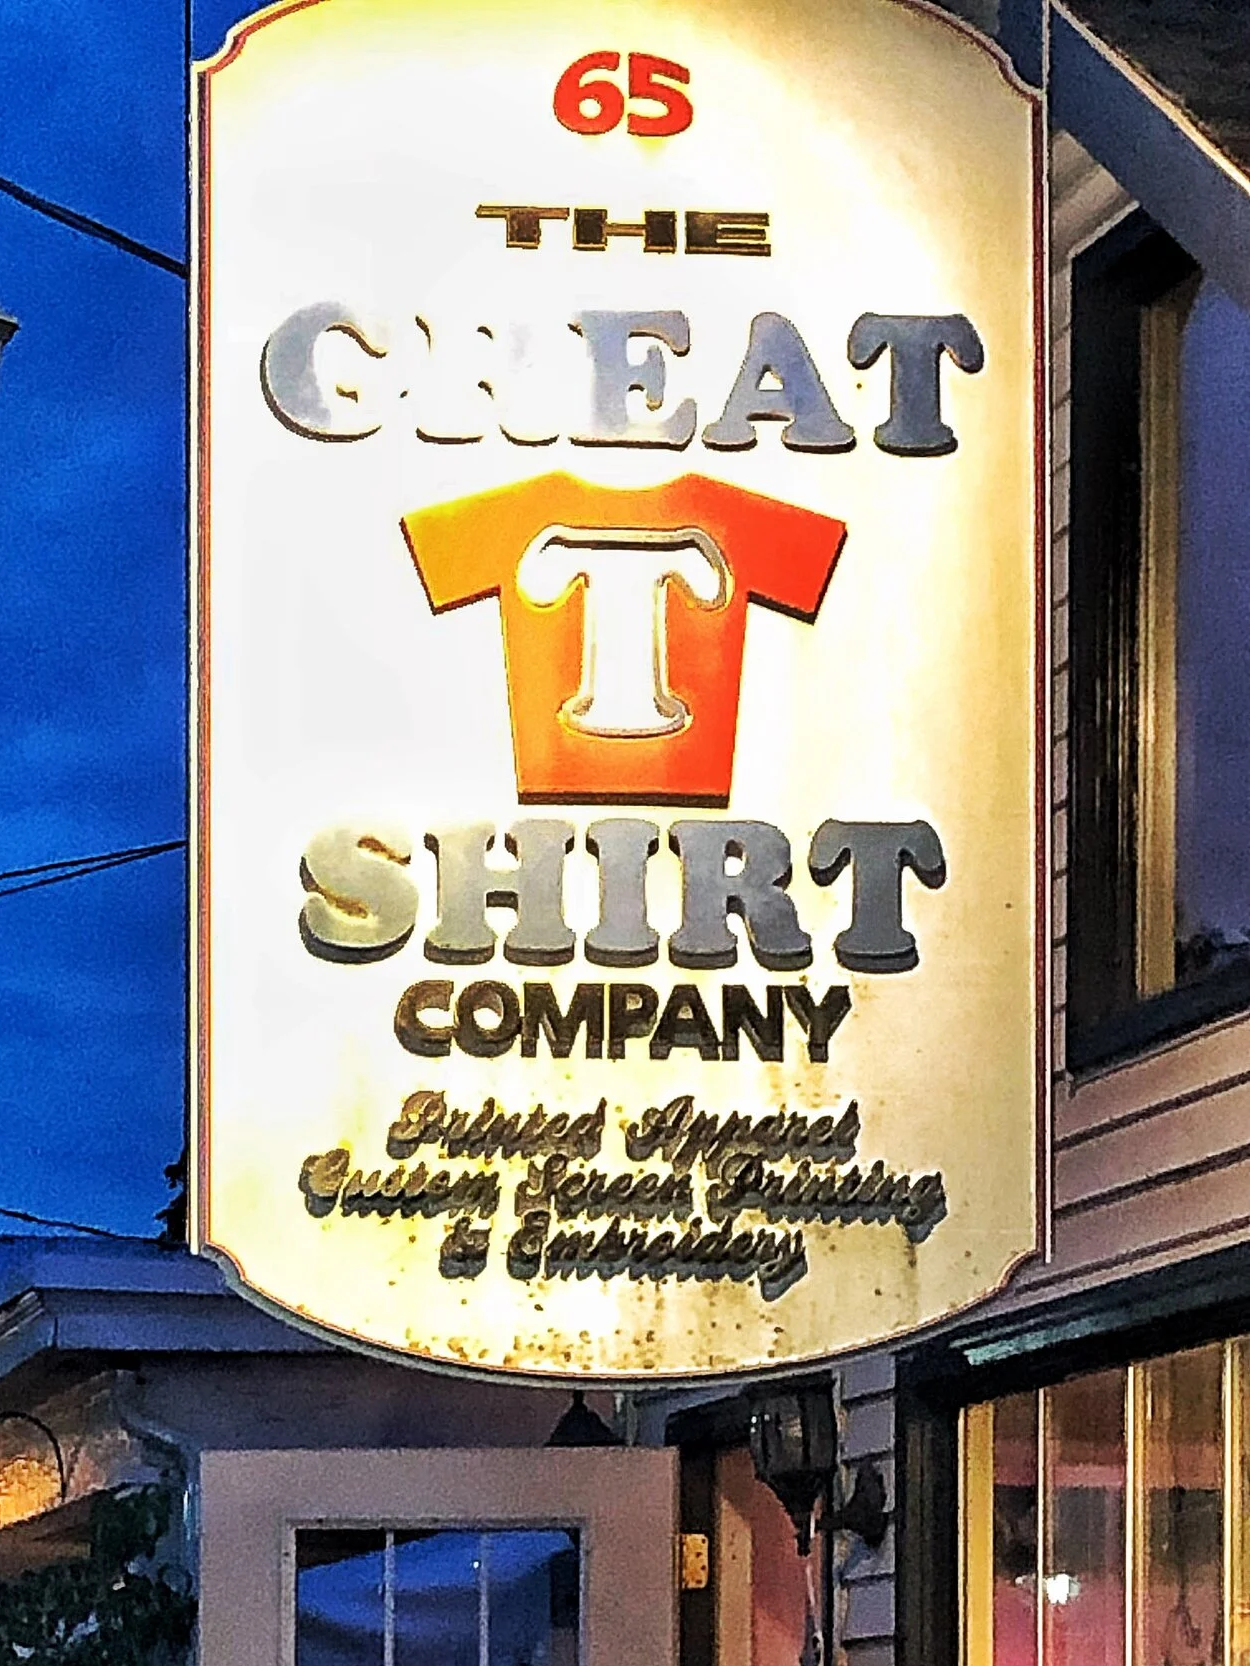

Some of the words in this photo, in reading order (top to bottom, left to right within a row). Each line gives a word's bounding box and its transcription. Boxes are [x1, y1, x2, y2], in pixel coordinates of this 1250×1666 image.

[553, 51, 693, 136] 65
[476, 204, 771, 257] THE
[259, 301, 985, 457] GREAT
[517, 523, 732, 738] T
[298, 818, 947, 974] SHIRT
[393, 979, 854, 1063] COMPANY
[386, 1090, 606, 1163] Printed
[626, 1095, 860, 1179] Apparel
[300, 1146, 500, 1218] Custom
[515, 1152, 693, 1225] Screen
[706, 1154, 947, 1243] Printing
[439, 1219, 488, 1279] &
[507, 1211, 807, 1302] Embroidery
